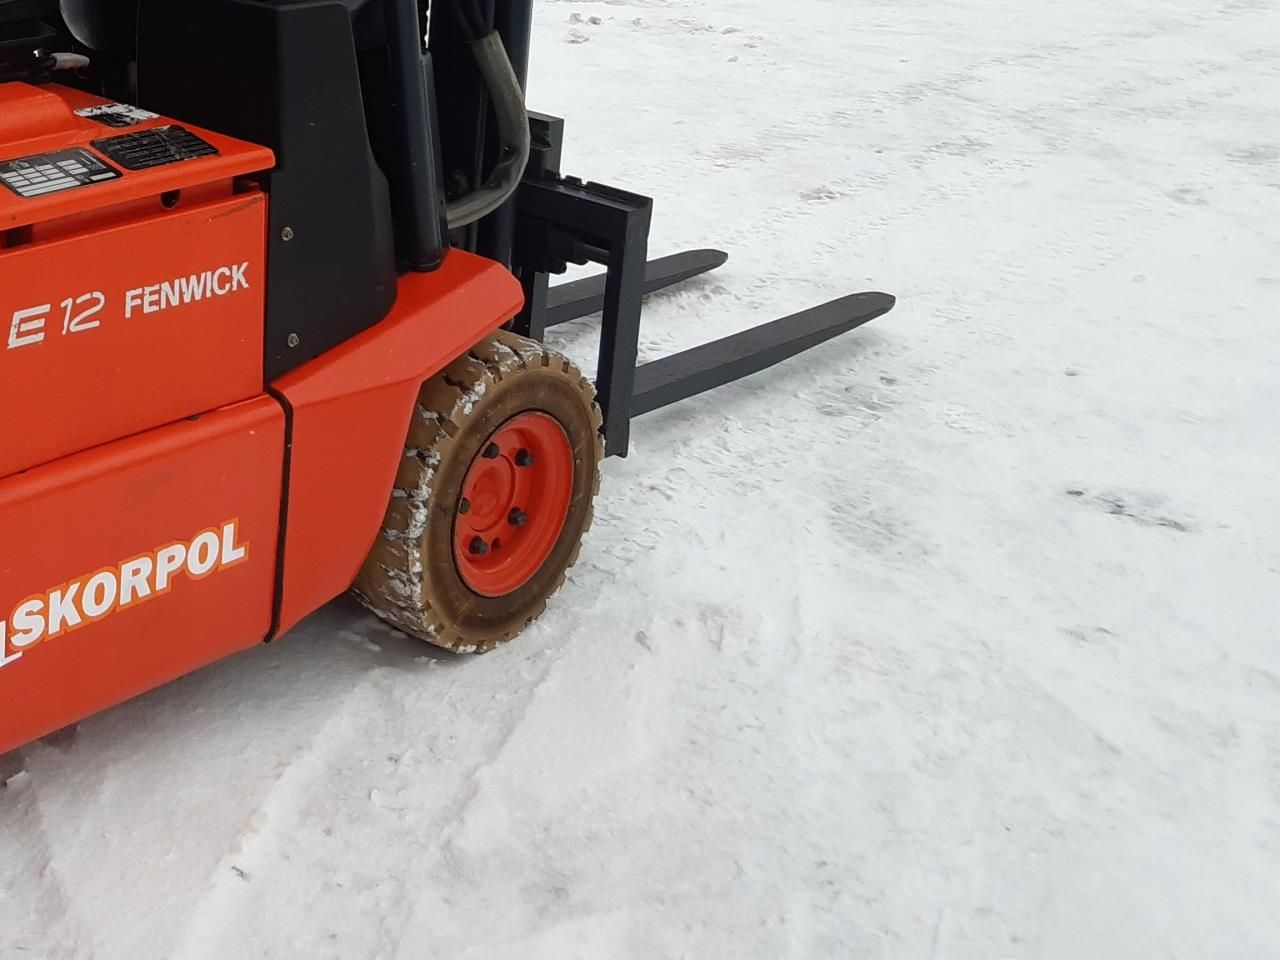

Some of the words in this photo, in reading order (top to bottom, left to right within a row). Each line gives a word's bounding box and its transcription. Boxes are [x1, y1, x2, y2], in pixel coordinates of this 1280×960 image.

[7, 303, 51, 349] E
[60, 291, 105, 335] 12
[124, 262, 250, 319] FENWICK
[10, 522, 247, 648] SKORPOL
